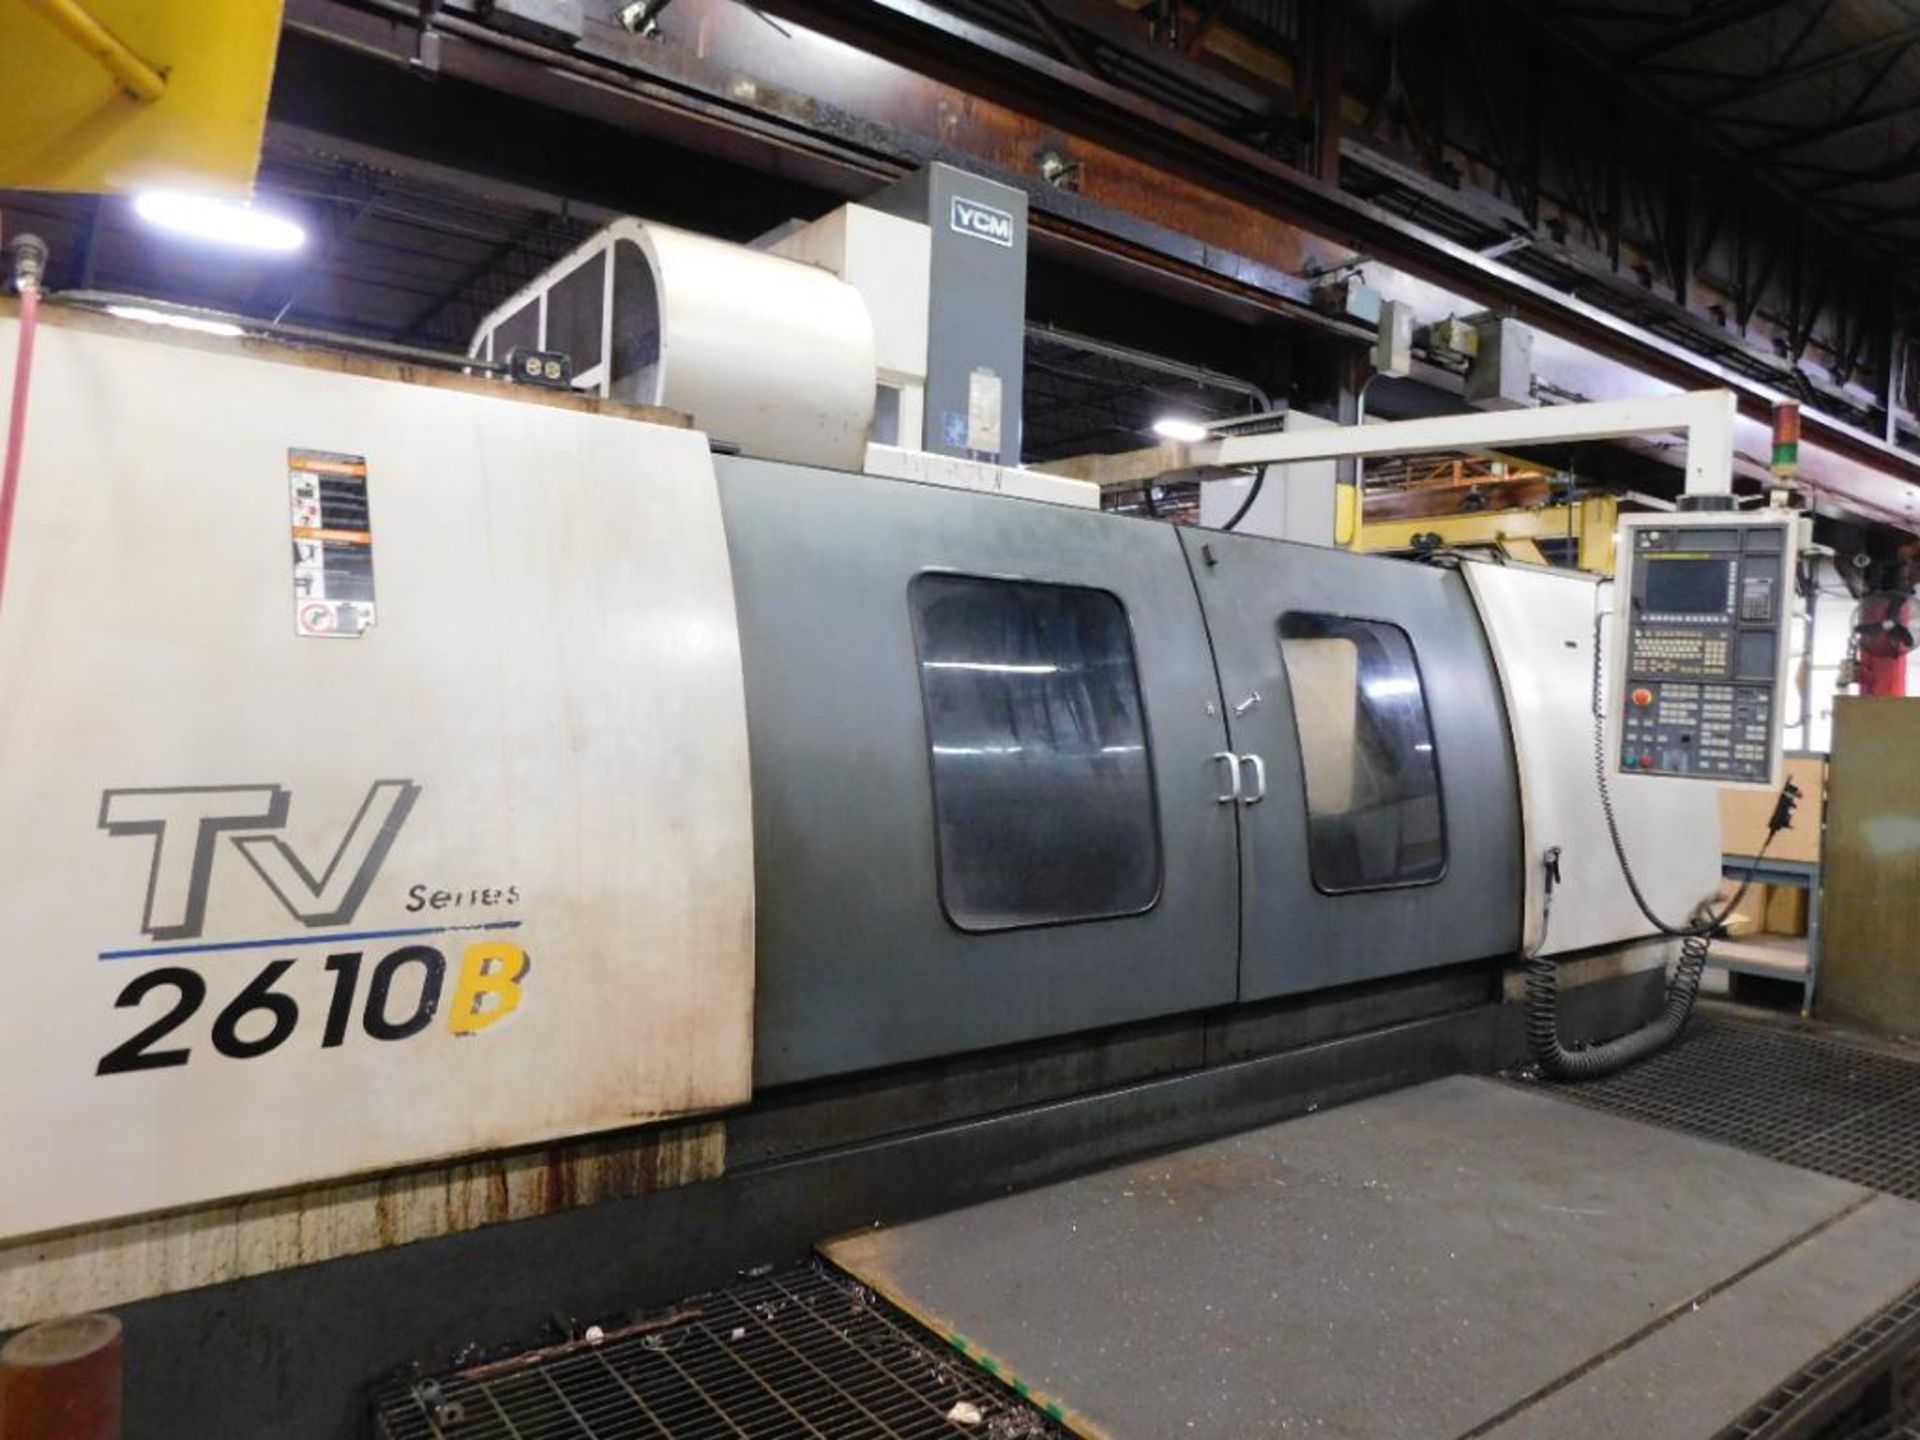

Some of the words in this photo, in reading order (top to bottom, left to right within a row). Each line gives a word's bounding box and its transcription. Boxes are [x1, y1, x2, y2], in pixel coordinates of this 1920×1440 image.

[957, 204, 1008, 237] YCM
[97, 779, 422, 941] TV
[95, 941, 531, 1077] 2610B
